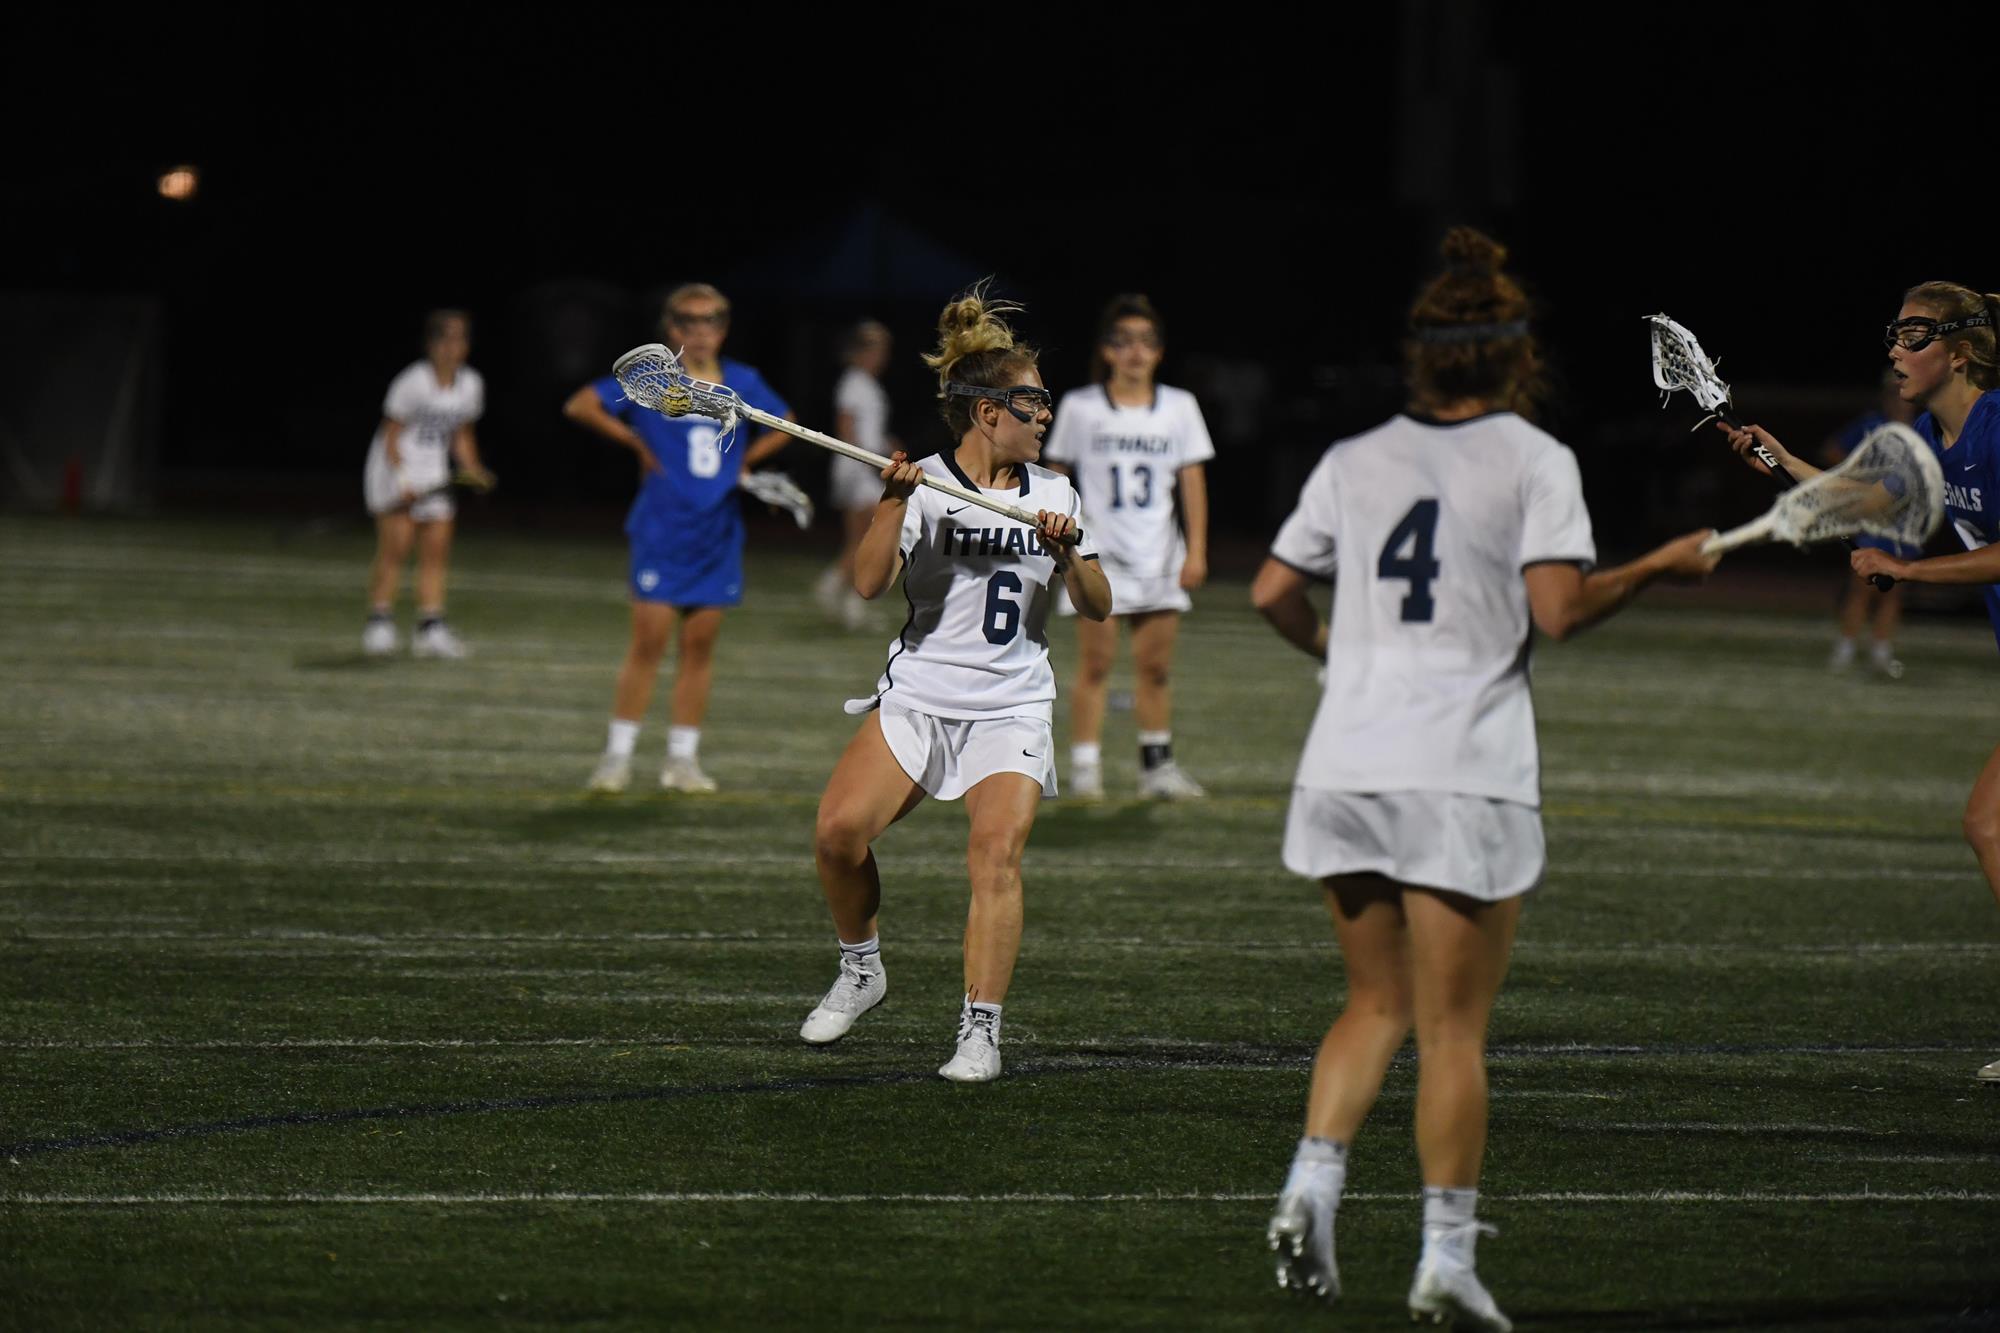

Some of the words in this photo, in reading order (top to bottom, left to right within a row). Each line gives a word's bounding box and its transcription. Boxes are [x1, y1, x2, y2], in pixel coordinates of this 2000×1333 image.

[1753, 445, 1779, 468] STX
[1109, 464, 1153, 509] 13
[943, 527, 1050, 557] ITHAC
[1378, 498, 1440, 622] 4
[982, 570, 1022, 646] 6
